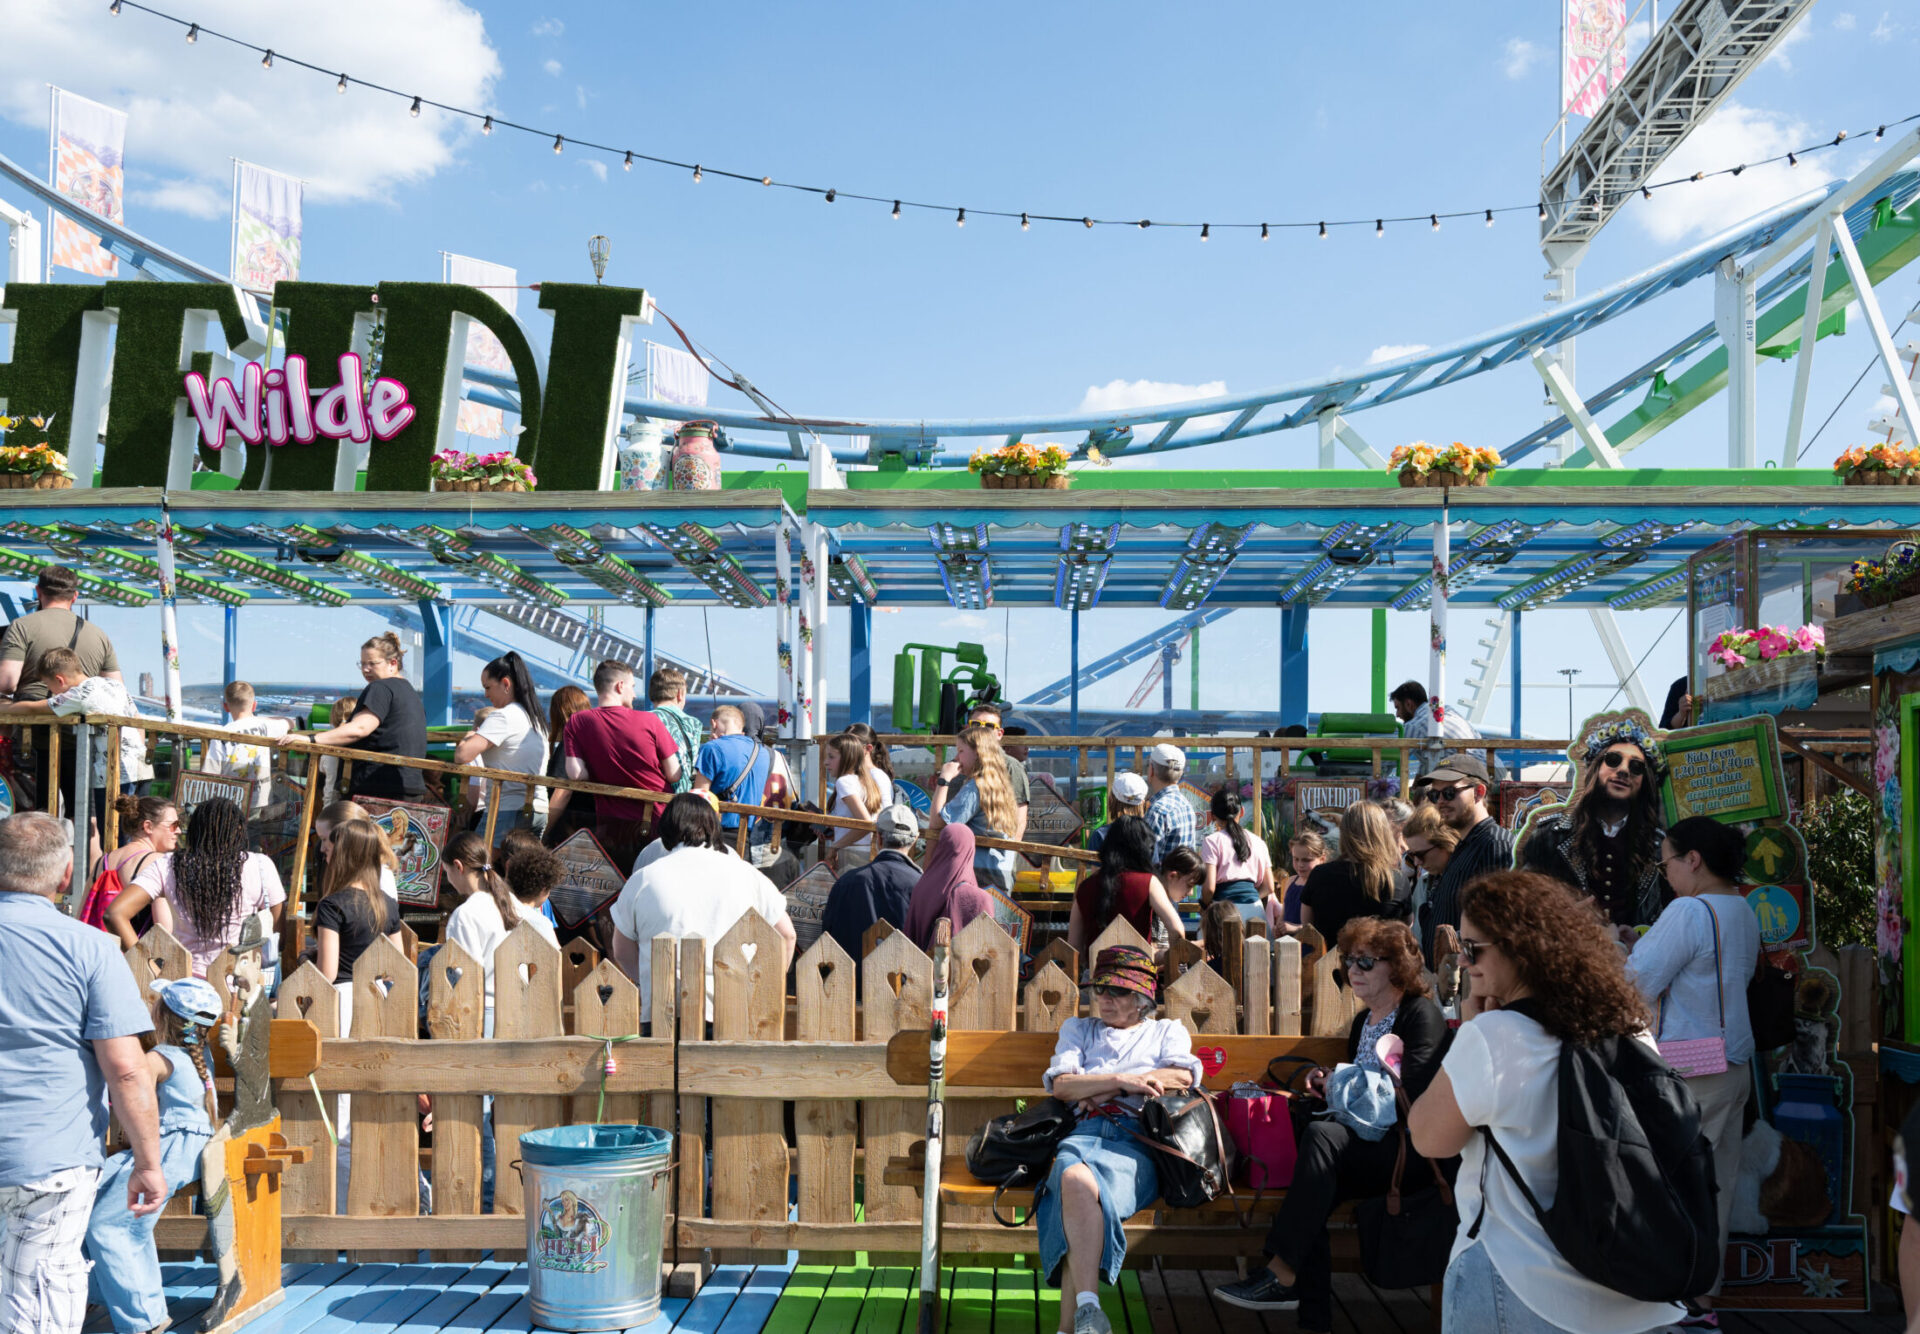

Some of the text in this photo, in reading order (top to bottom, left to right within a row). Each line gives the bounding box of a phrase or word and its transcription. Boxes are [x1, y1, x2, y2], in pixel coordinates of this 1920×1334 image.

[184, 351, 416, 450] Wilde
[1685, 747, 1736, 764] Kids from
[1697, 765, 1707, 775] m
[1708, 760, 1719, 772] to
[1743, 756, 1754, 767] m
[1686, 779, 1752, 801] accompanied
[1690, 770, 1743, 788] only when
[182, 778, 245, 811] SCHNEIDER
[1301, 786, 1360, 814] SCHNEIDER
[1692, 792, 1751, 815] by an adult
